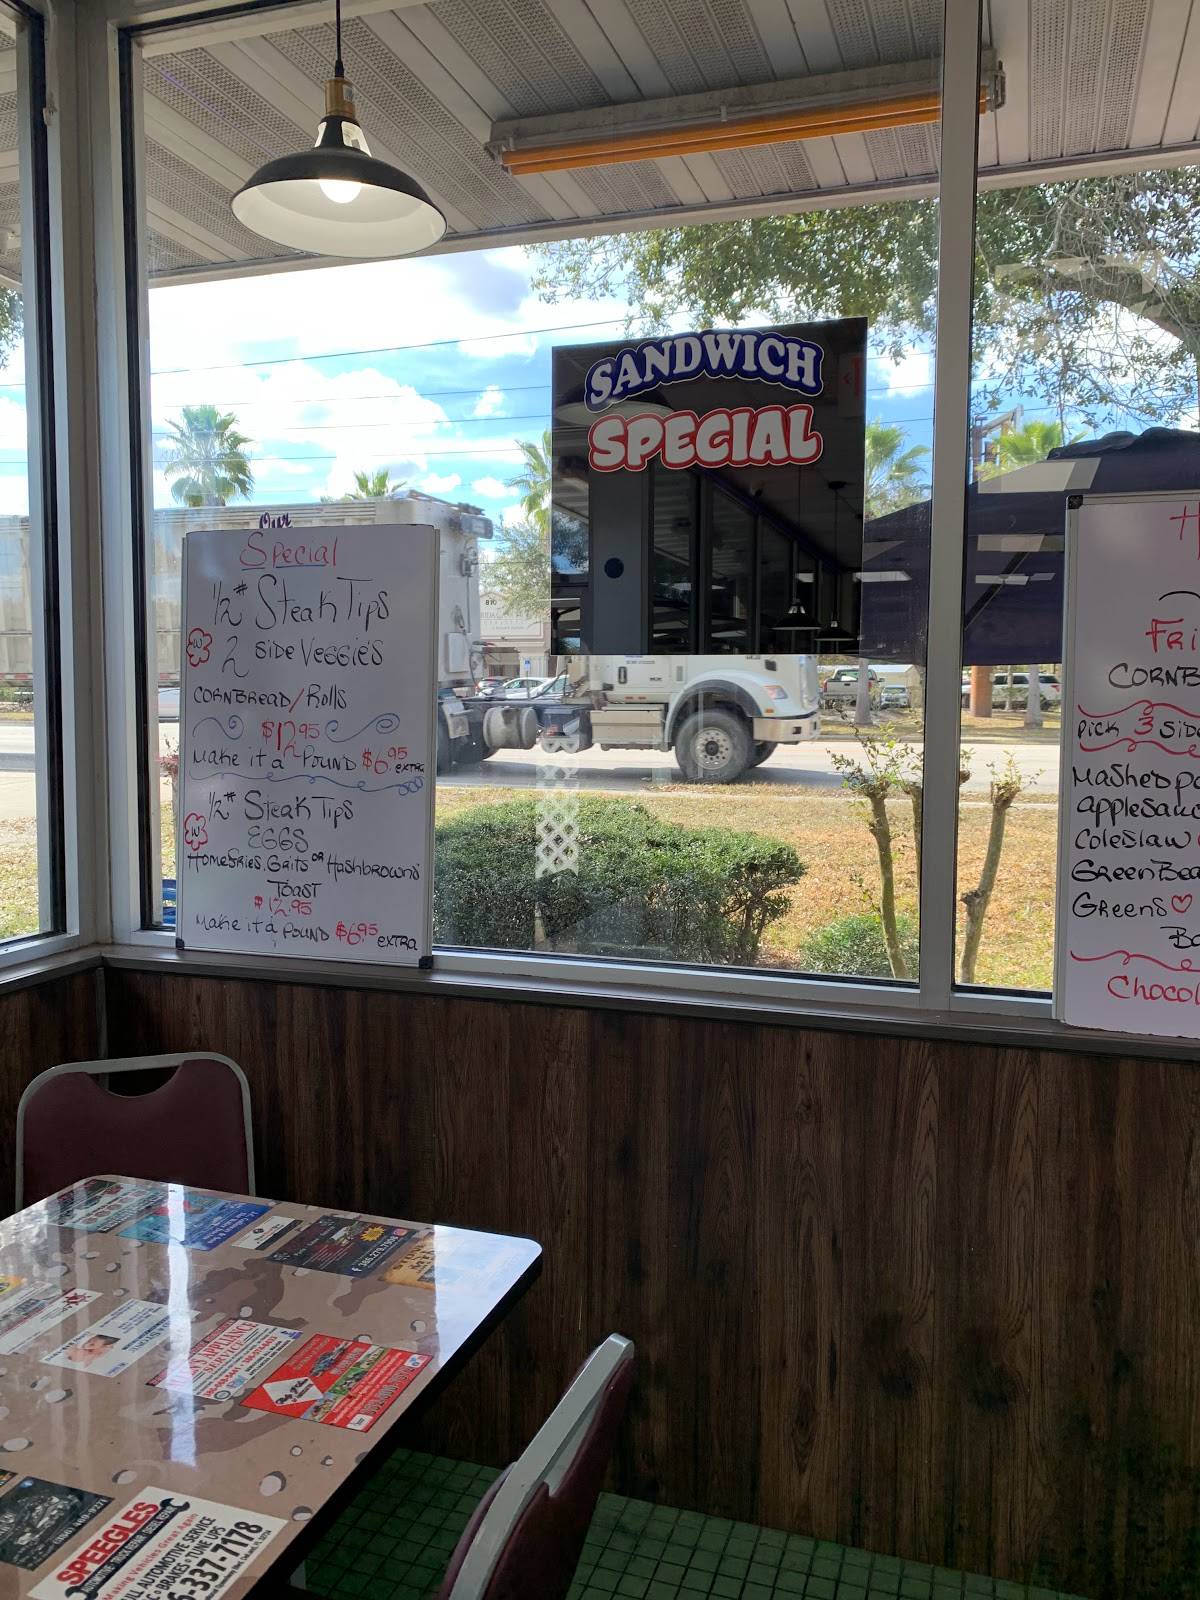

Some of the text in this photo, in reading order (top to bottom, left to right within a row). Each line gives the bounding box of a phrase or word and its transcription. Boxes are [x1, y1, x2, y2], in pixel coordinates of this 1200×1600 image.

[585, 329, 824, 413] SANDWICH
[588, 403, 823, 472] SPECIAL
[239, 531, 338, 568] Special
[255, 574, 338, 630] Steak
[336, 576, 390, 632] Tips
[221, 635, 249, 678] 2
[1134, 716, 1154, 735] 3
[249, 746, 267, 767] it
[271, 758, 285, 769] a
[244, 790, 311, 821] Steak
[311, 796, 354, 829] Tips
[56, 1502, 159, 1585] SPEEGLES
[132, 1549, 160, 1576] Vehicles
[158, 1531, 178, 1549] Great
[177, 1513, 199, 1531] Again
[141, 1543, 186, 1590] AUTOMOTIVE
[182, 1516, 216, 1544] SERVICE
[156, 1526, 226, 1590] BRAKES TUNE UPS
